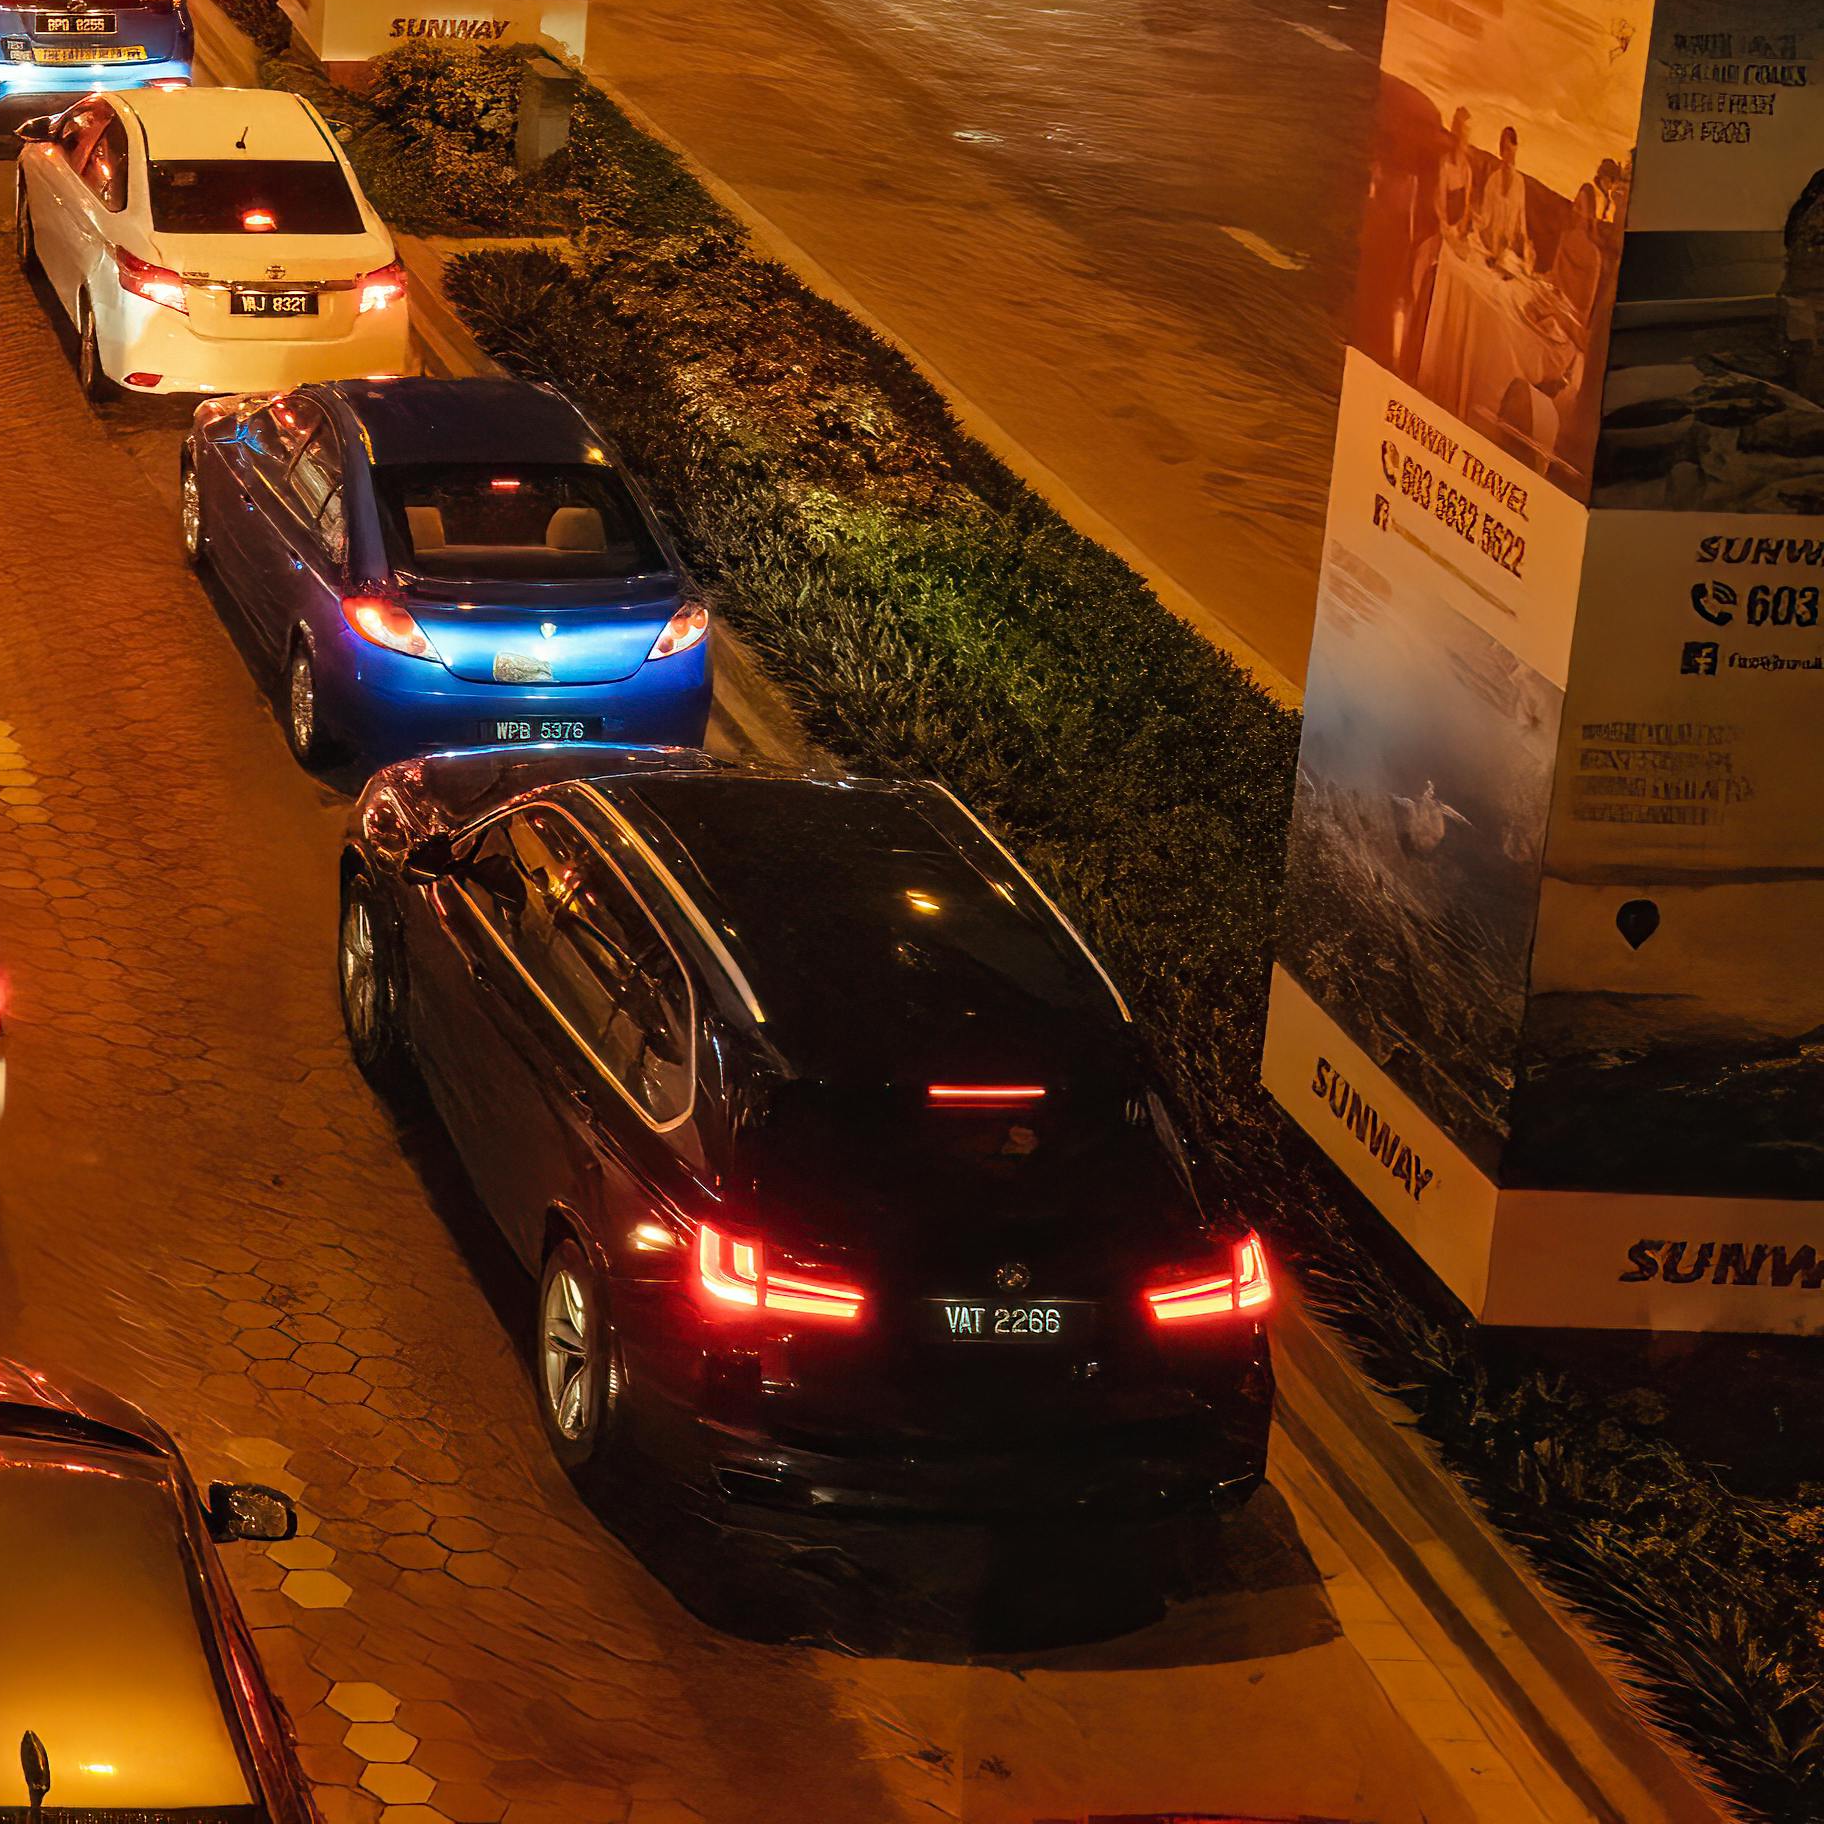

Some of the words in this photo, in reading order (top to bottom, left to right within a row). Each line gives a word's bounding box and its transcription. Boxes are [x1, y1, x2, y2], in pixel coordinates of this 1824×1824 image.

[389, 17, 511, 39] SUNWAY
[1384, 399, 1459, 464] SUNWAY
[1462, 449, 1529, 522] TRAVEL
[1402, 455, 1433, 510] 603
[1746, 584, 1820, 627] 603
[1312, 1056, 1434, 1201] SUNWAY
[945, 1306, 986, 1334] VAT
[994, 1307, 1062, 1334] 2266
